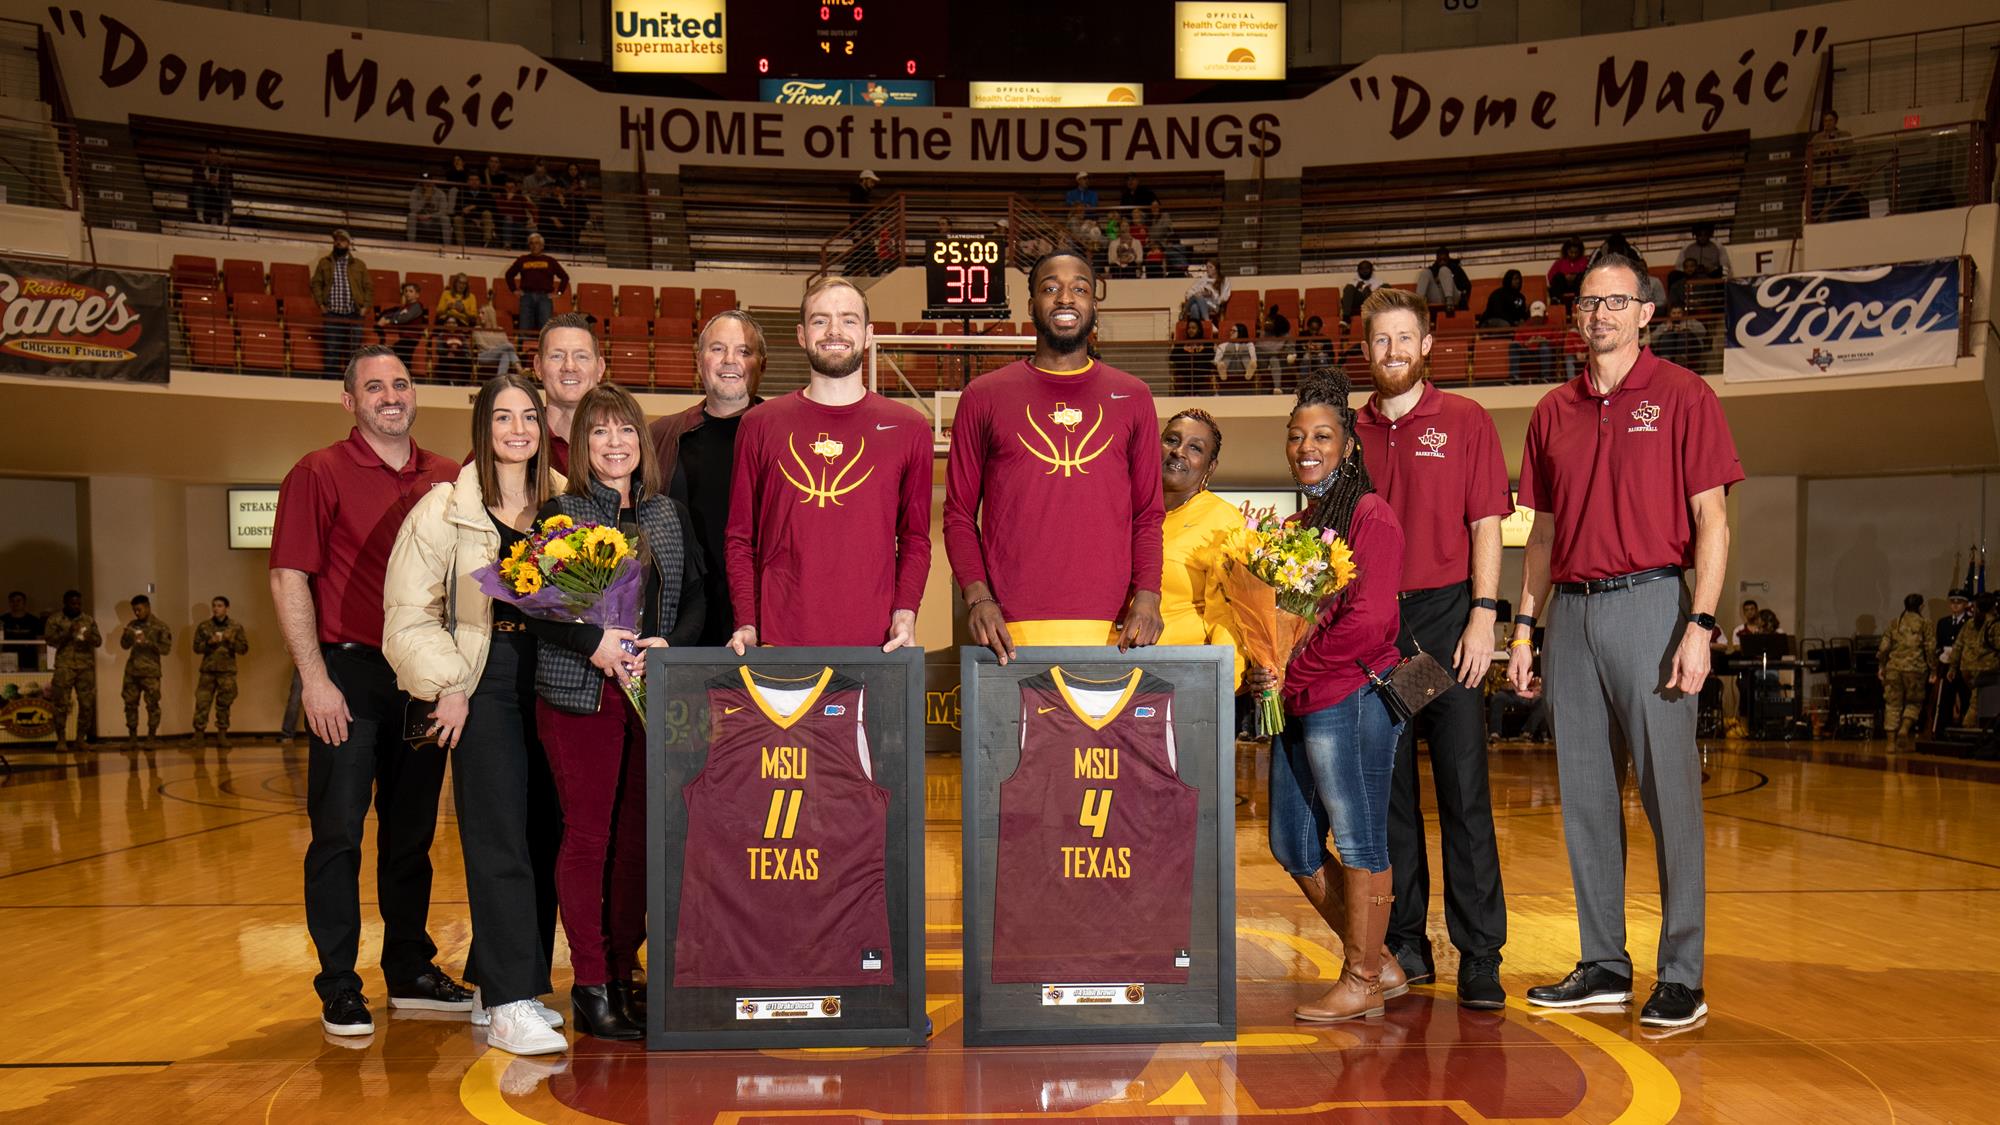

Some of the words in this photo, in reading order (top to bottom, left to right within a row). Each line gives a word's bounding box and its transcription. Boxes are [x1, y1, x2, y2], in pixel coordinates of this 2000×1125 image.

[821, 6, 830, 20] 0
[853, 6, 863, 20] 0
[615, 11, 722, 38] United
[1183, 21, 1212, 29] Health
[1215, 21, 1238, 29] Care
[1240, 21, 1278, 30] Provider
[615, 40, 723, 56] supermarkets
[821, 41, 830, 53] 4
[845, 41, 854, 55] 2
[759, 58, 769, 73] 0
[907, 60, 916, 74] 0
[1027, 95, 1062, 103] Provider
[620, 105, 785, 157] HOME
[804, 108, 854, 159] of
[870, 109, 951, 160] the
[970, 112, 1282, 162] MUSTANGS
[933, 241, 998, 264] 25:00
[1756, 250, 1773, 273] F
[22, 279, 86, 300] Raising
[946, 265, 989, 303] 30
[1735, 265, 1947, 349] Ford
[20, 340, 70, 355] CHICKEN
[1634, 406, 1660, 420] MSU
[1422, 433, 1447, 446] MSU
[761, 746, 807, 779] MSU
[1074, 747, 1119, 779] MSU
[763, 788, 804, 839] 11
[1079, 788, 1113, 838] 4
[746, 847, 819, 880] TEXAS
[1061, 846, 1131, 879] TEXAS
[869, 951, 875, 959] L
